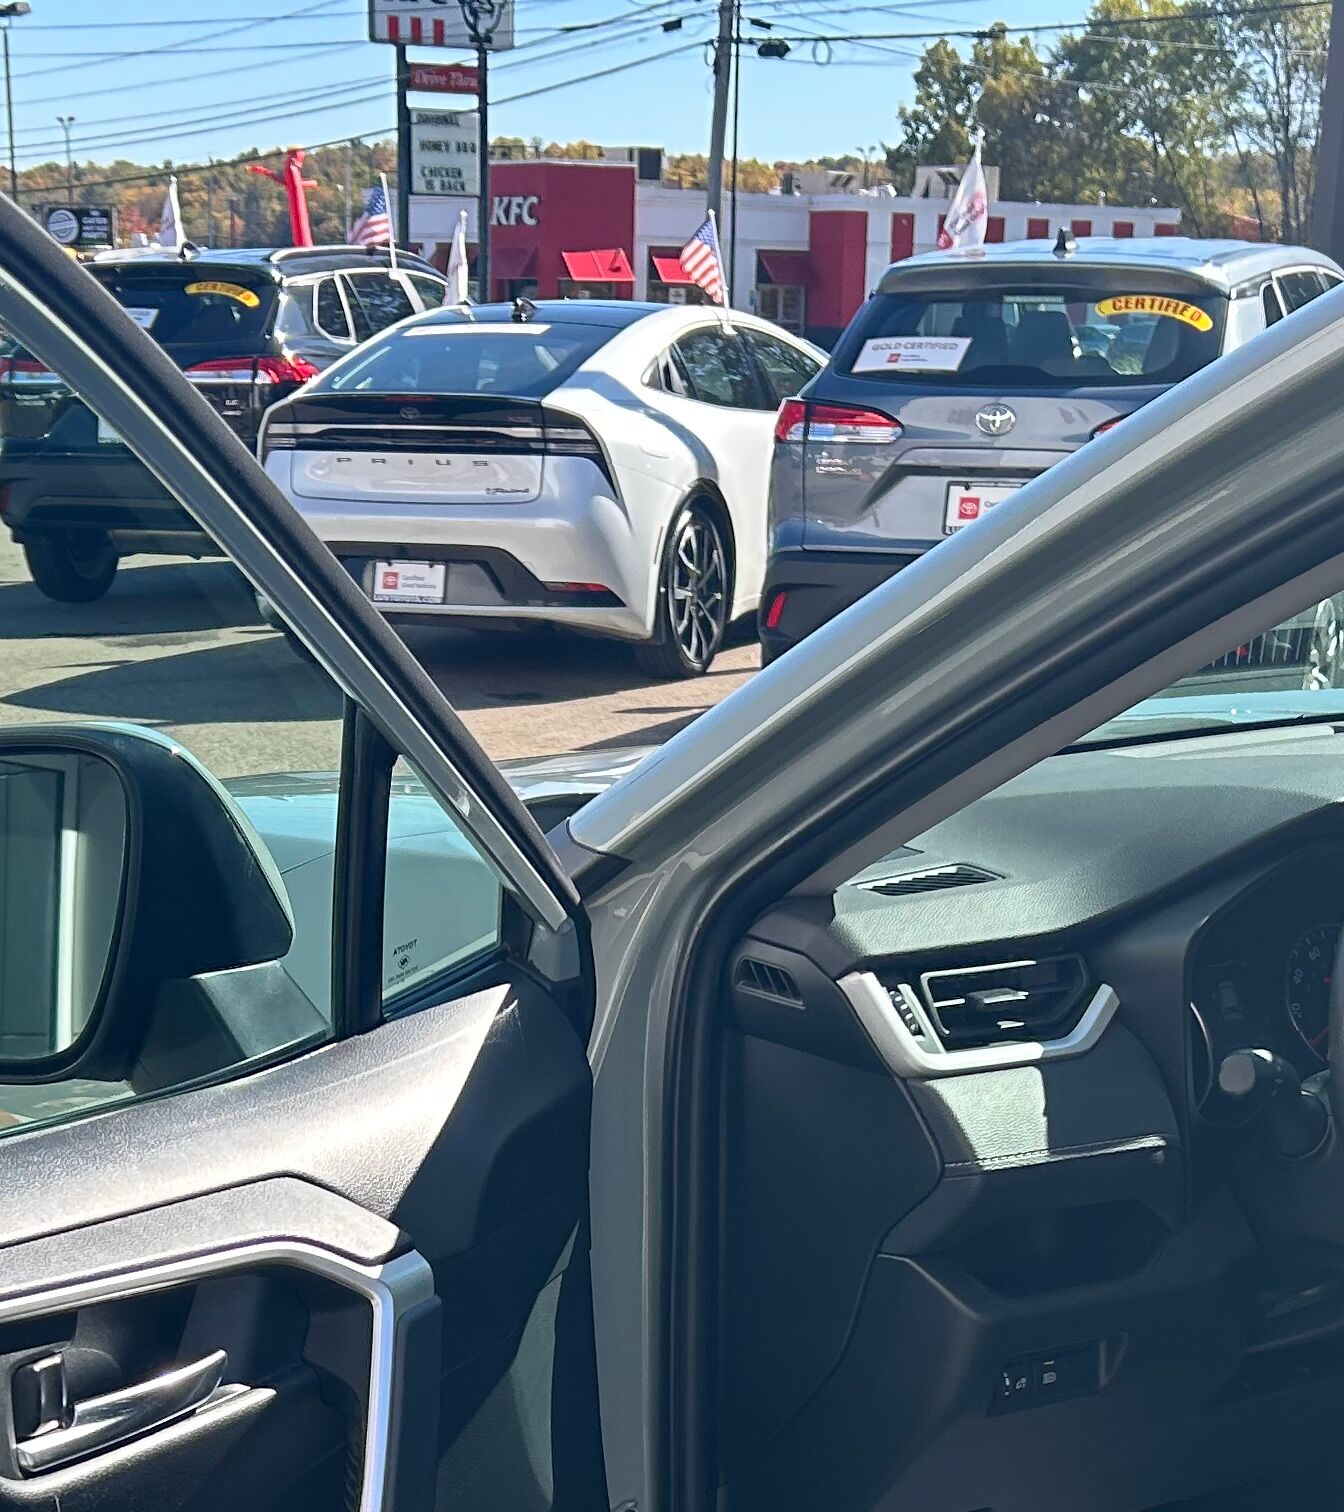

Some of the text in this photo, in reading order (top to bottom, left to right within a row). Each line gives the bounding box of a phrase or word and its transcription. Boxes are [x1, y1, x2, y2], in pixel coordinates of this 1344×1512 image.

[490, 196, 540, 226] KFC
[1112, 297, 1202, 322] CERTIFIED
[336, 456, 489, 467] PRIUS
